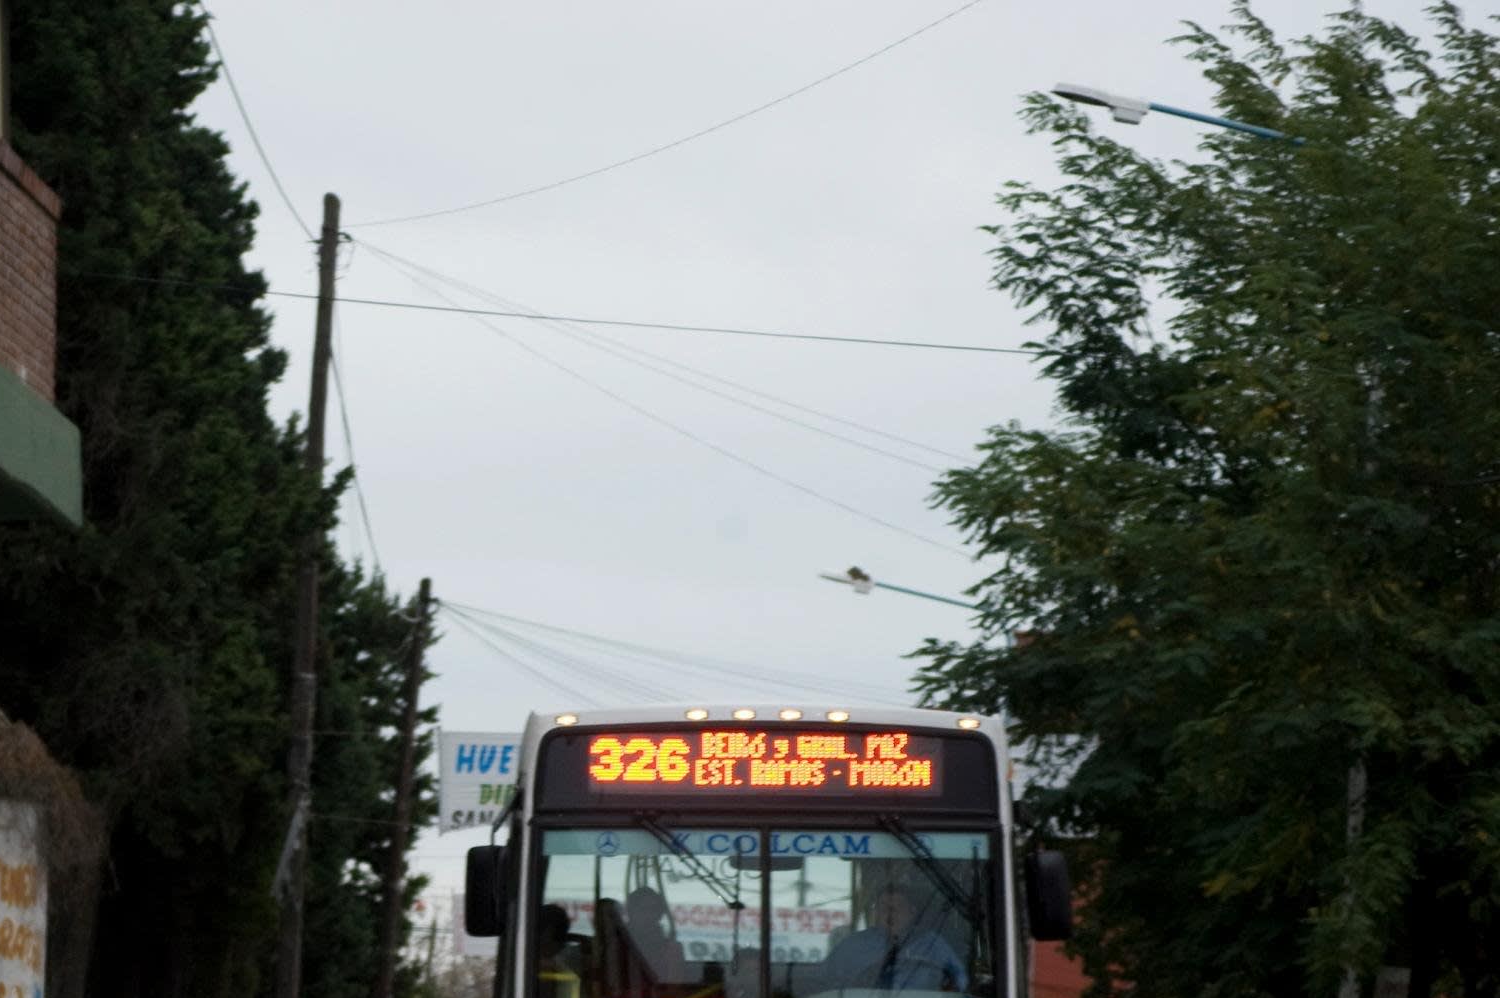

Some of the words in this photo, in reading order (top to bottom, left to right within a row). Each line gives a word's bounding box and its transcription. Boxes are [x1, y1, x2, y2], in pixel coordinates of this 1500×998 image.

[588, 736, 691, 783] 326
[694, 759, 743, 785] EST.
[706, 833, 871, 855] COLCAM
